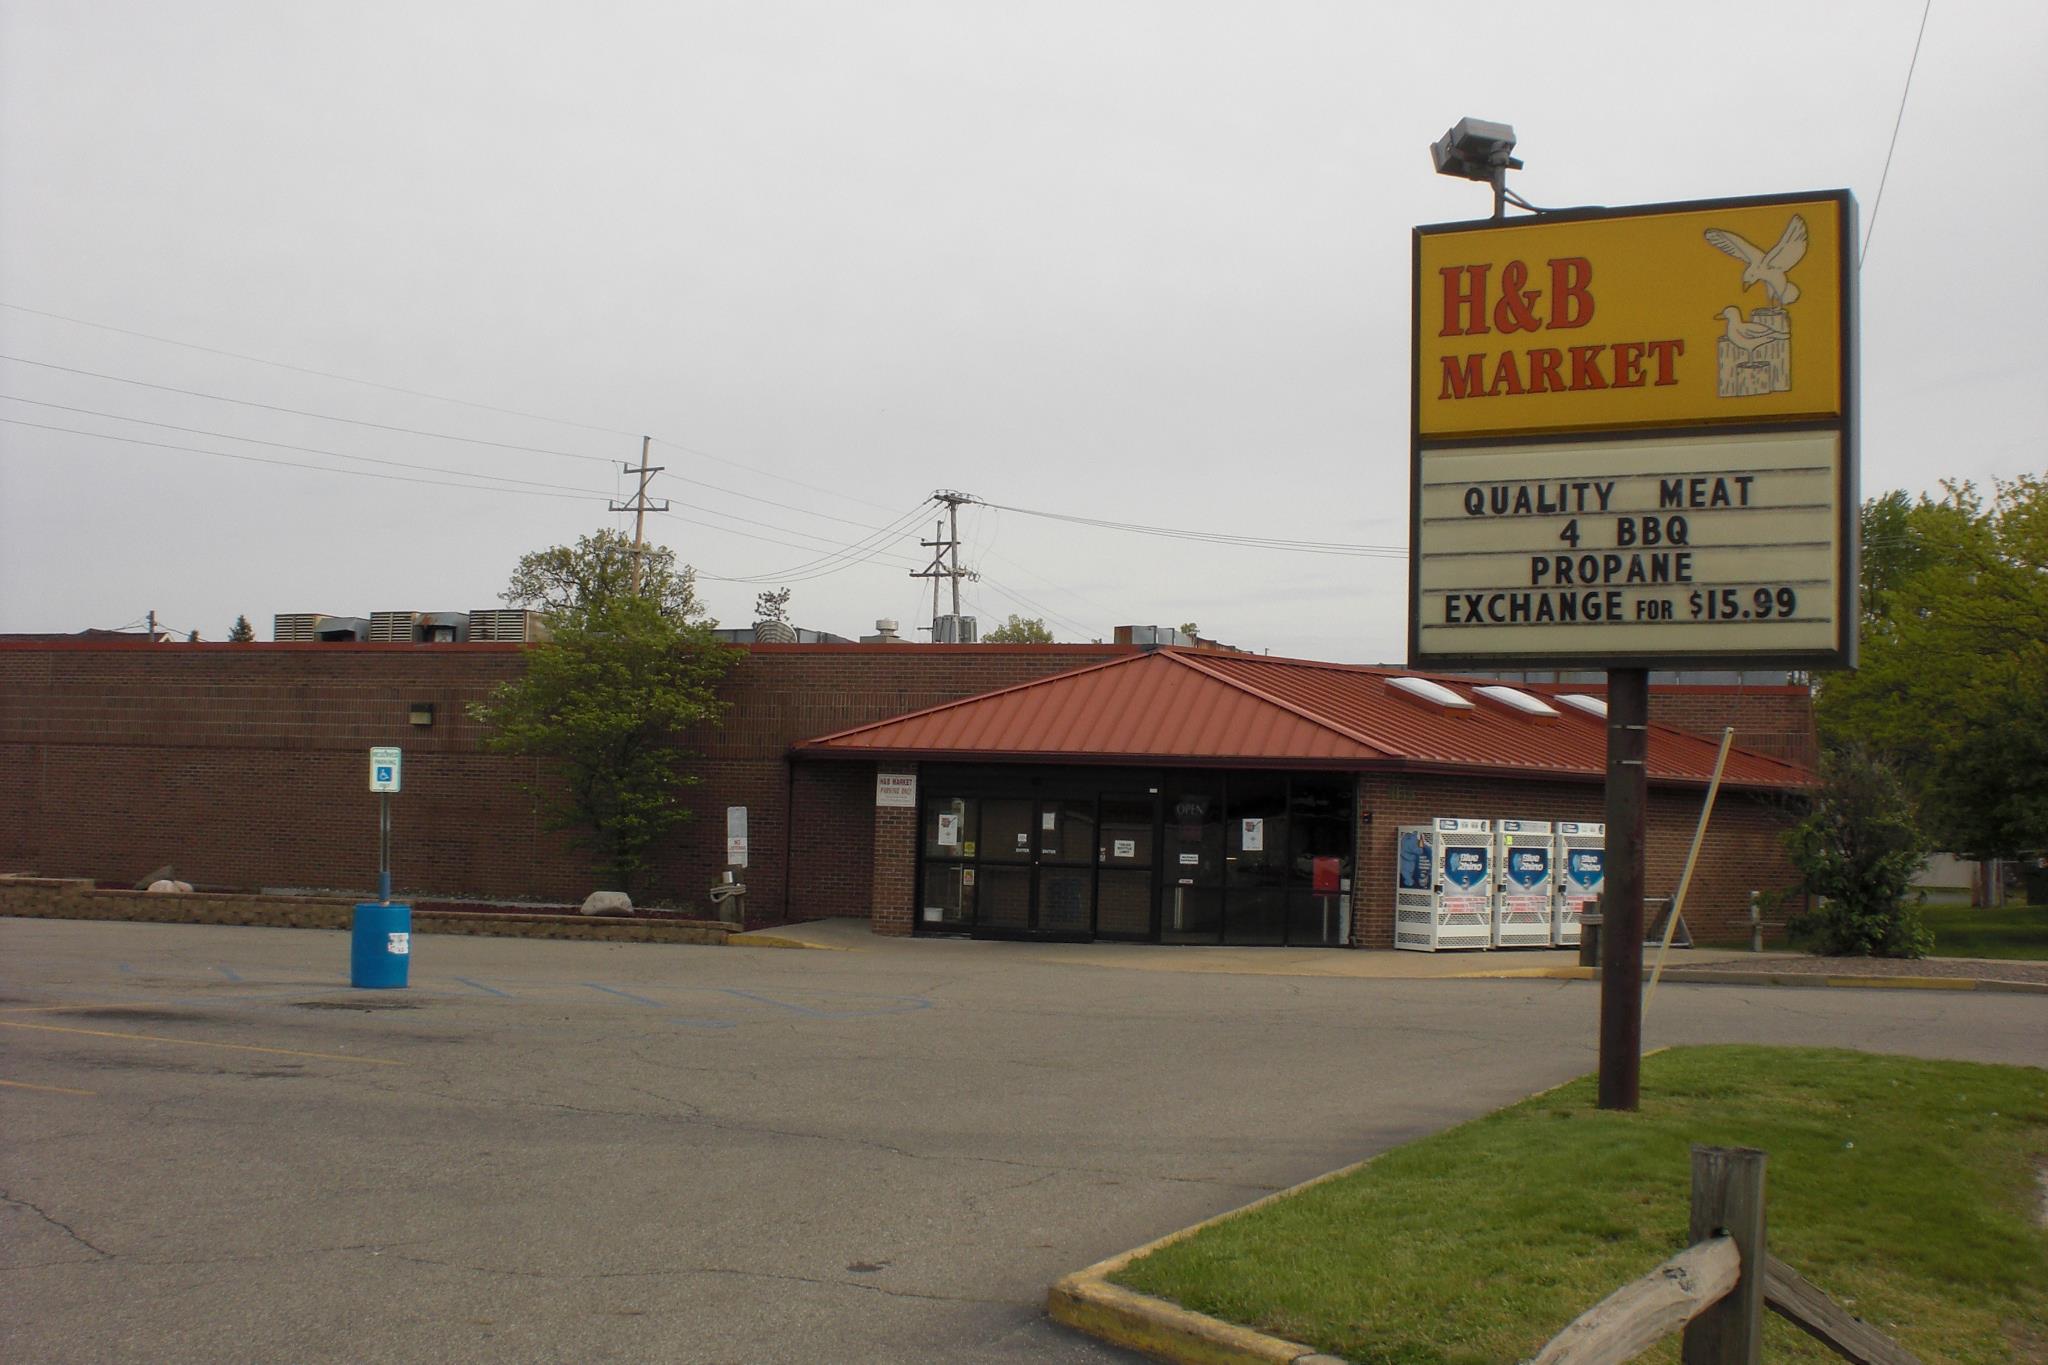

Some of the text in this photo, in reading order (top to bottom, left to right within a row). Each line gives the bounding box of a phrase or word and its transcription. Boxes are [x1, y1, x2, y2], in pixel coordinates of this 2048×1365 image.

[1438, 256, 1595, 338] H&B
[1438, 339, 1684, 400] MARKET
[1464, 476, 1754, 516] QUALITY MEAT
[1559, 516, 1689, 547] 4 BBQ
[1531, 552, 1693, 585] PROPANE
[1445, 587, 1797, 624] EXCHANGE FOR $15.99
[1176, 803, 1204, 816] OPEN
[1457, 862, 1483, 871] Rhino
[1460, 853, 1479, 862] Blue
[1521, 854, 1540, 862] Blue
[1580, 855, 1598, 863] Blue
